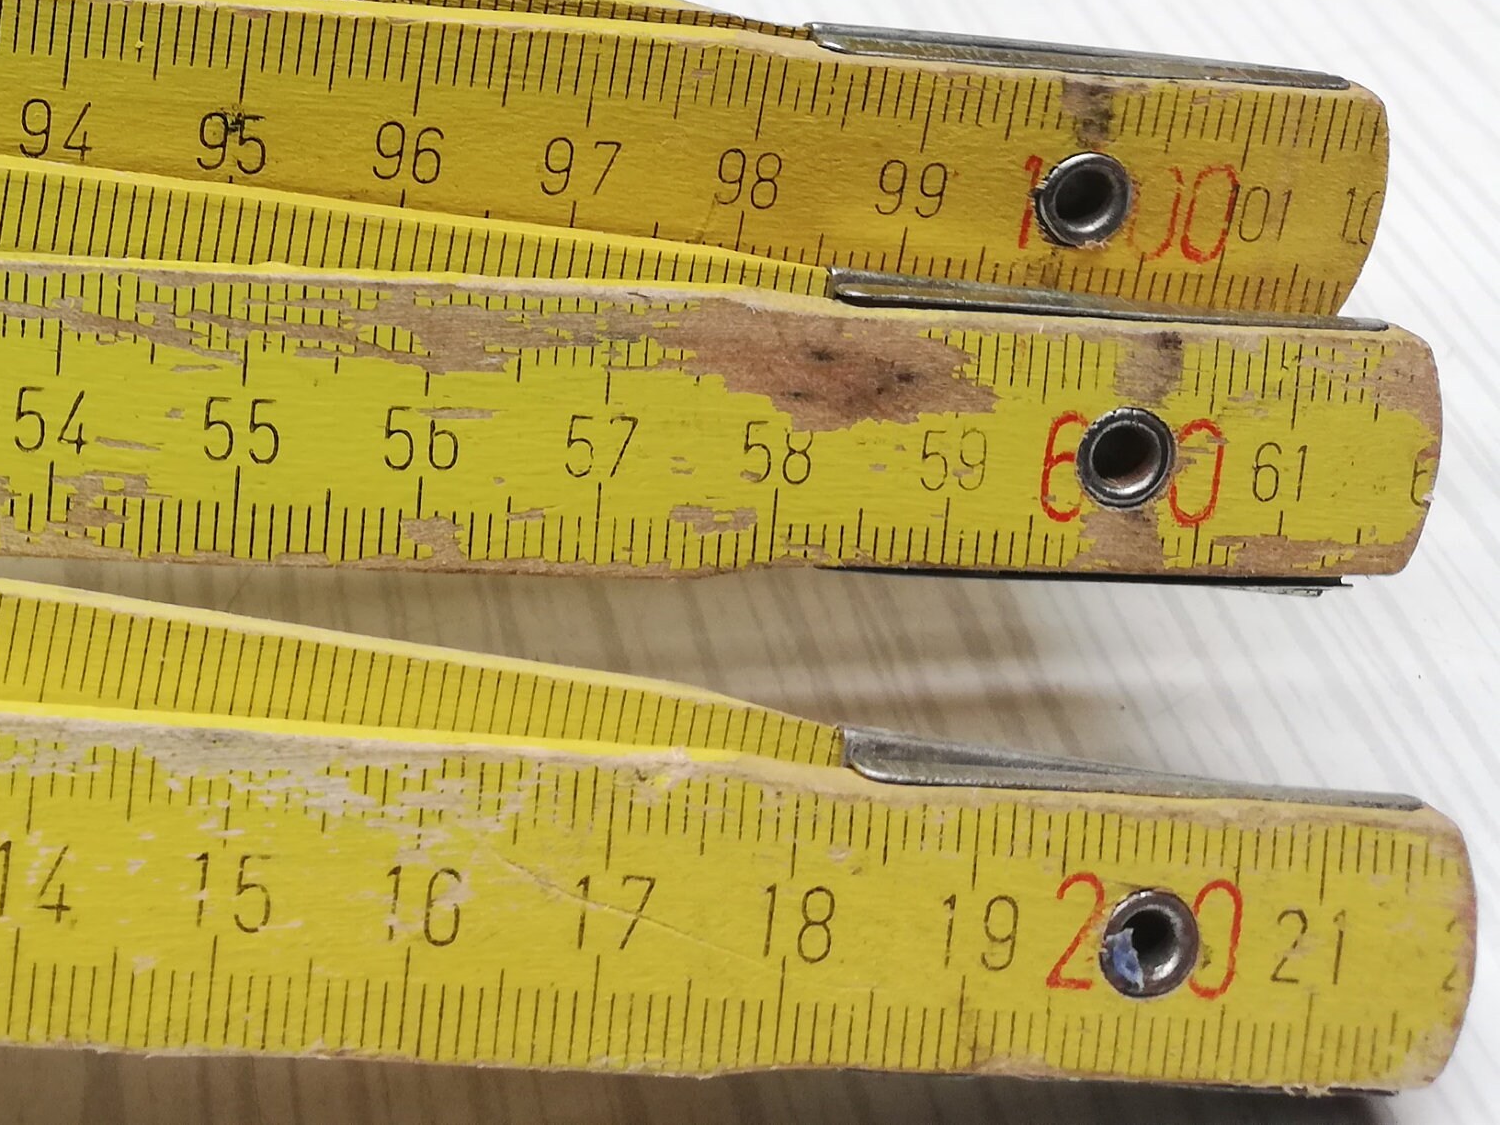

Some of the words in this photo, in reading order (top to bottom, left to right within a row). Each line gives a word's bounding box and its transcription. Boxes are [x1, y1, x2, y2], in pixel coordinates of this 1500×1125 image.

[18, 97, 93, 162] 94
[196, 110, 268, 177] 95
[371, 120, 444, 185] 96
[540, 136, 622, 197] 97
[713, 148, 783, 210] 98
[875, 158, 948, 218] 99
[14, 386, 88, 454] 54
[202, 398, 279, 465] 55
[383, 406, 460, 471] 56
[566, 416, 639, 478] 57
[742, 420, 813, 485] 58
[920, 428, 988, 492] 59
[1041, 409, 1225, 527] 60
[1252, 442, 1308, 503] 61
[195, 850, 272, 935] 15
[386, 865, 465, 947] 16
[576, 875, 656, 950] 17
[764, 883, 836, 964] 18
[942, 892, 1020, 972] 19
[1046, 871, 1244, 1000] 20
[1270, 908, 1348, 986] 21
